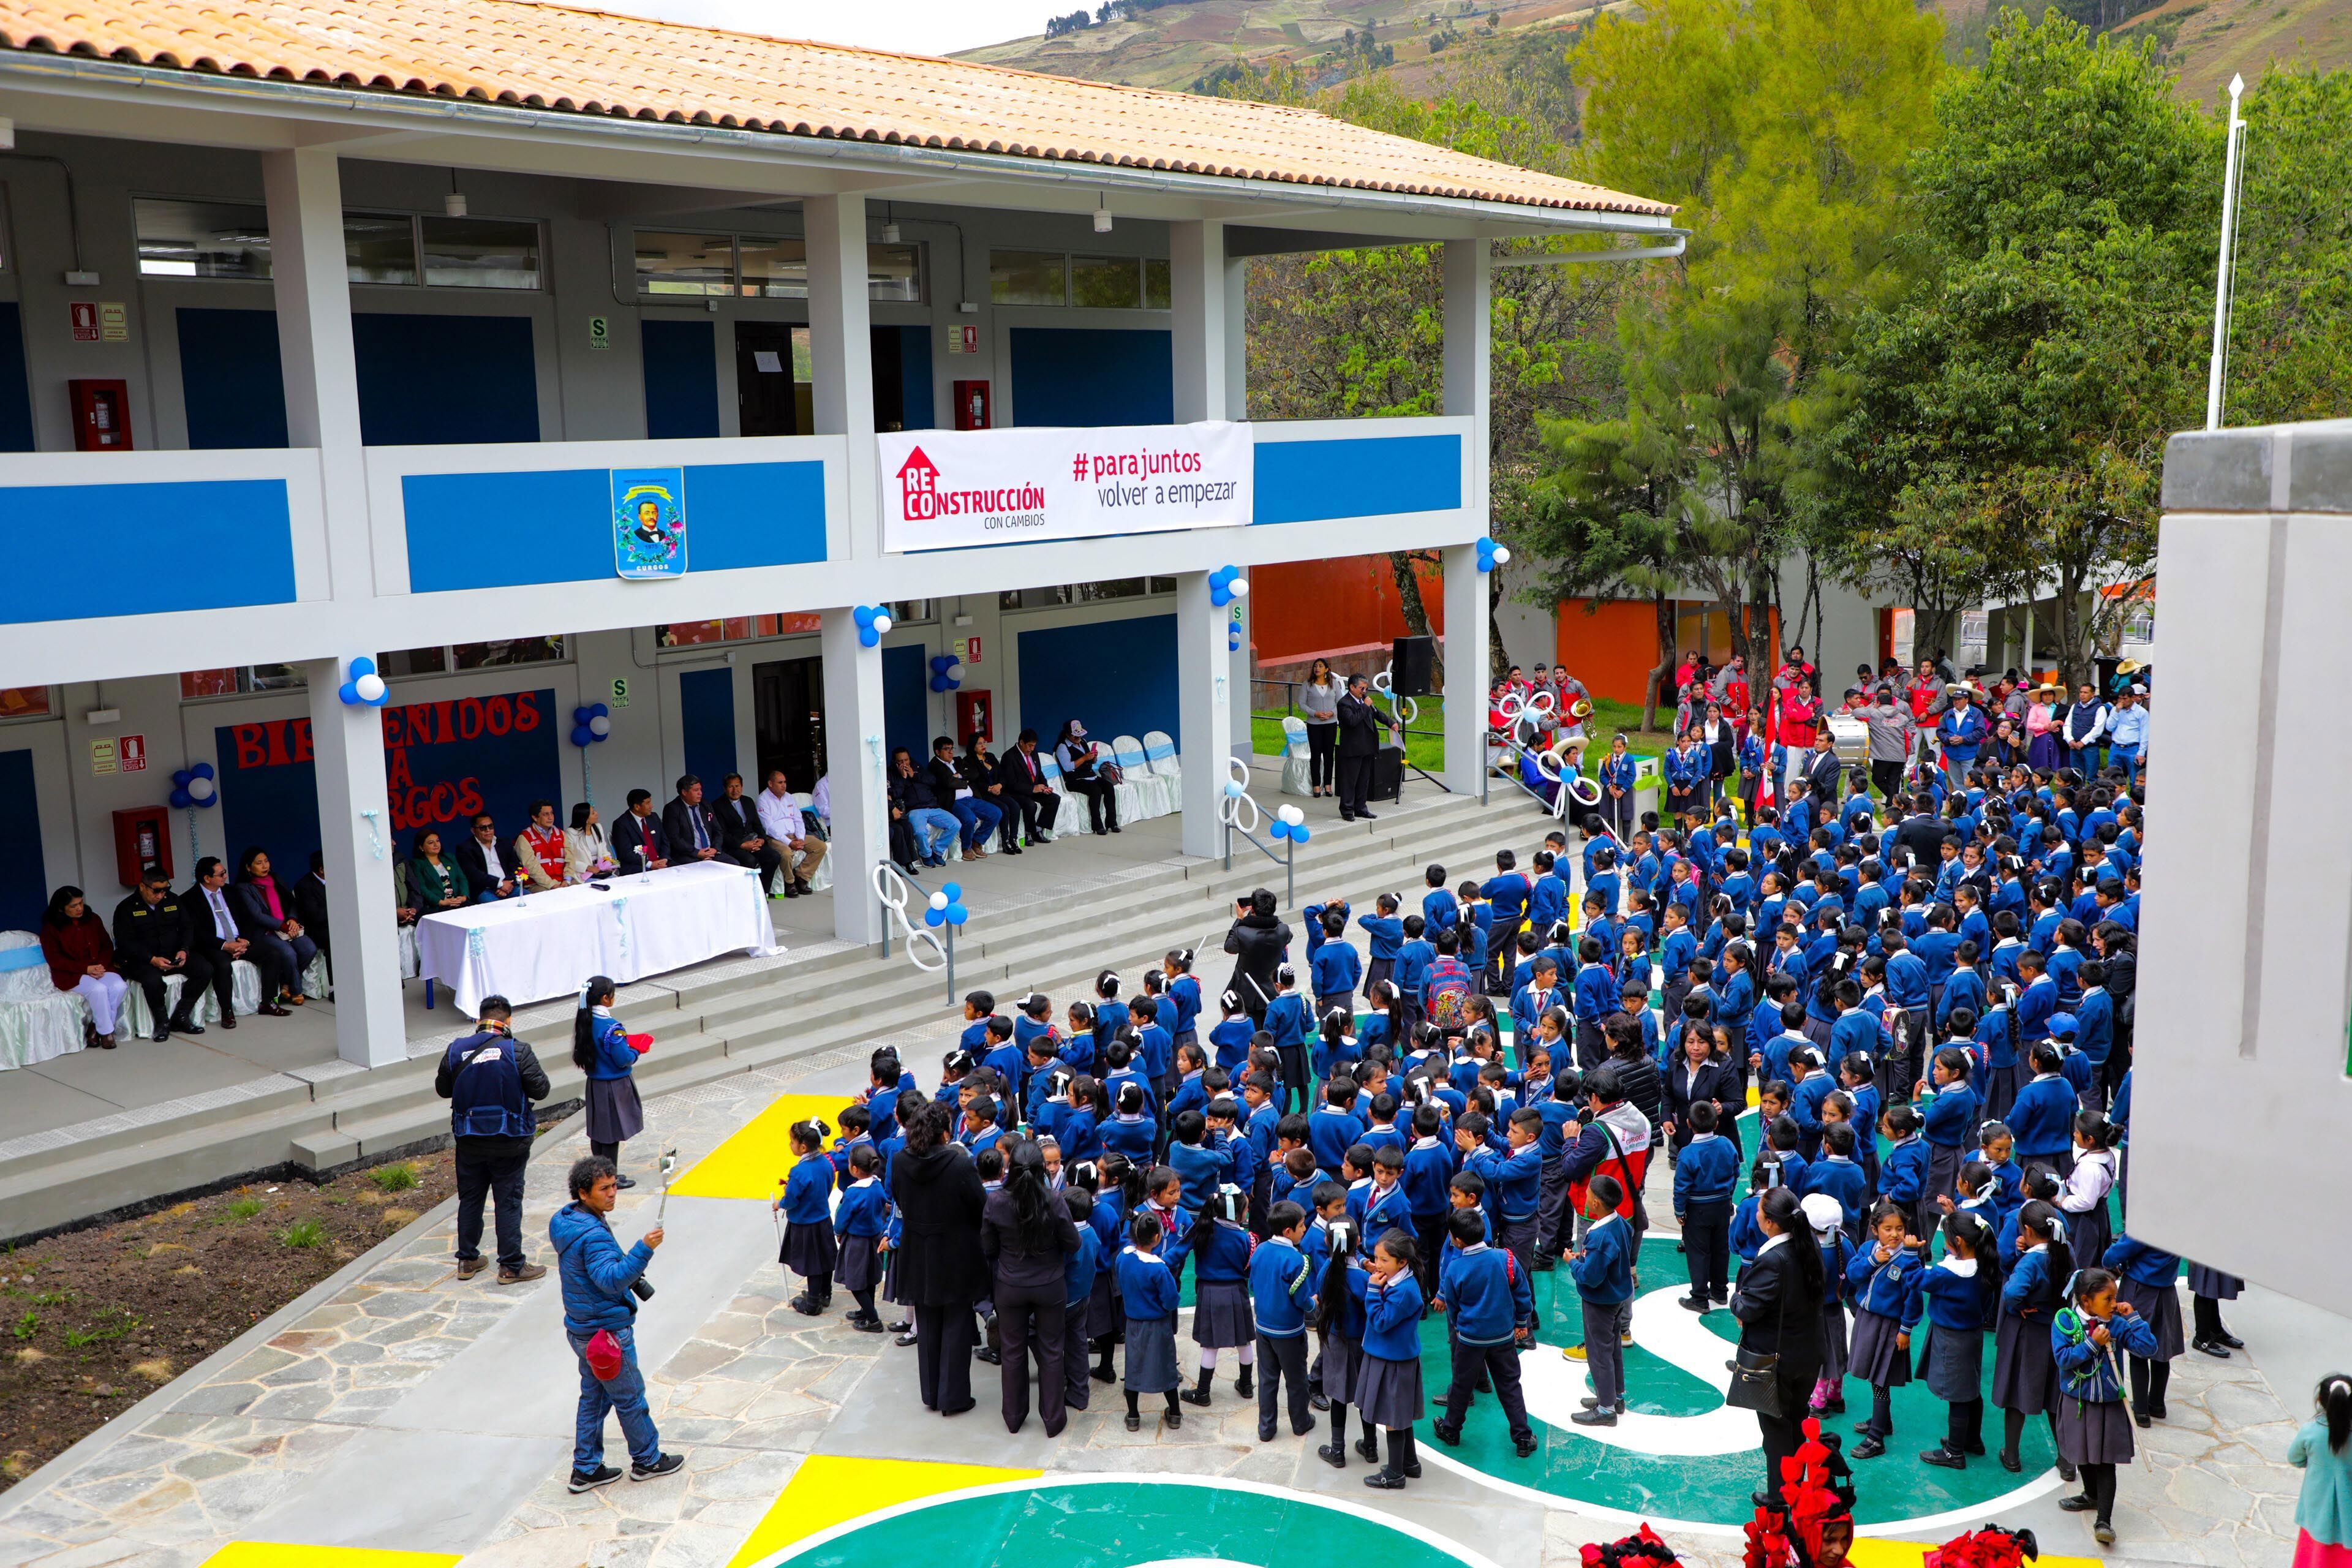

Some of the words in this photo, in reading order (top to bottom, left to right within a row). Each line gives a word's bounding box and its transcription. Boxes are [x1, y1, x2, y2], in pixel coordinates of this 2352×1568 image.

[593, 318, 605, 336] S
[907, 467, 932, 491] RE
[1098, 481, 1148, 507] volver
[1155, 486, 1164, 505] a
[1168, 481, 1237, 508] empezar
[984, 516, 1003, 530] CON
[1005, 513, 1045, 528] CAMBIOS
[1234, 606, 1241, 619] S
[614, 679, 625, 696] S
[232, 692, 540, 769] BIEENIDOS
[389, 748, 413, 790] A
[1626, 1133, 1645, 1145] CURGOS
